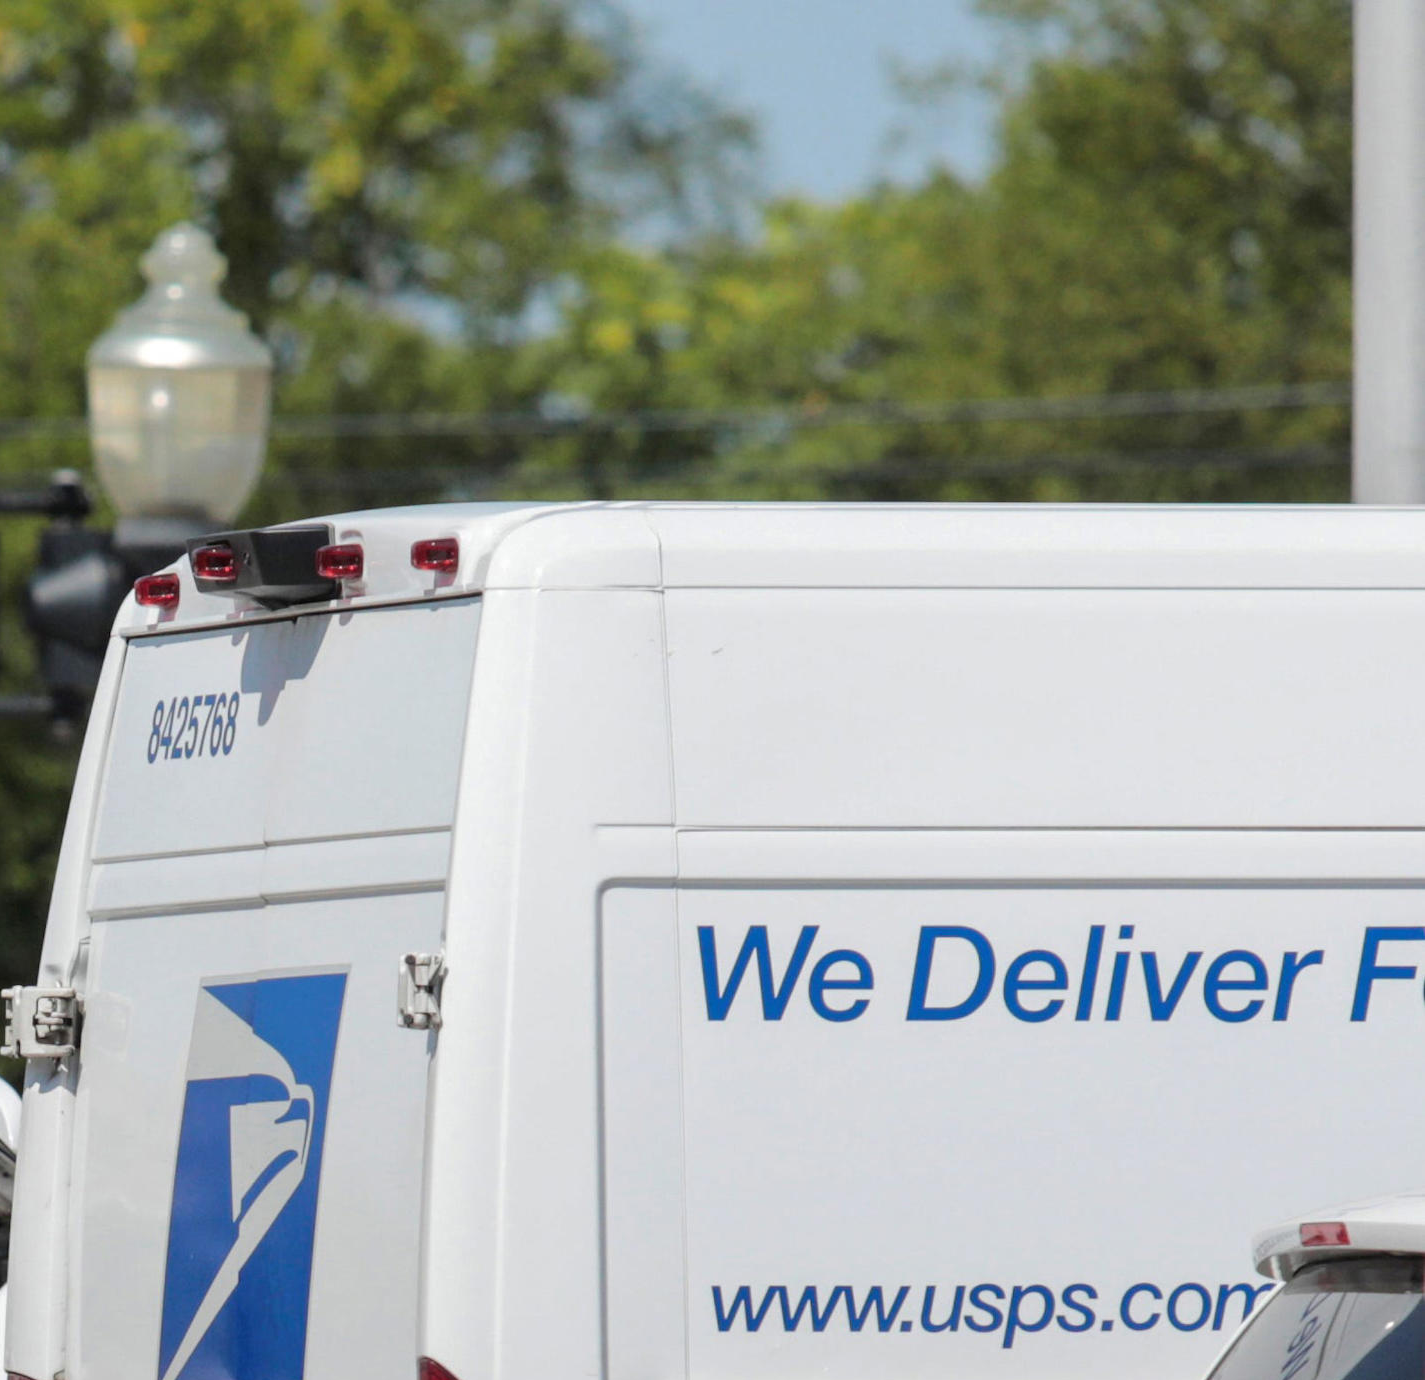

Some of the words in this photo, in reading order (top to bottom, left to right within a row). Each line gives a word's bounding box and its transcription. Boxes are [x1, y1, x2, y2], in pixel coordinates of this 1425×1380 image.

[147, 691, 240, 764] 8425768
[696, 925, 875, 1023] We
[905, 924, 1325, 1023] Deliver
[1349, 926, 1425, 1022] F
[711, 1283, 1276, 1349] www.usps.com
